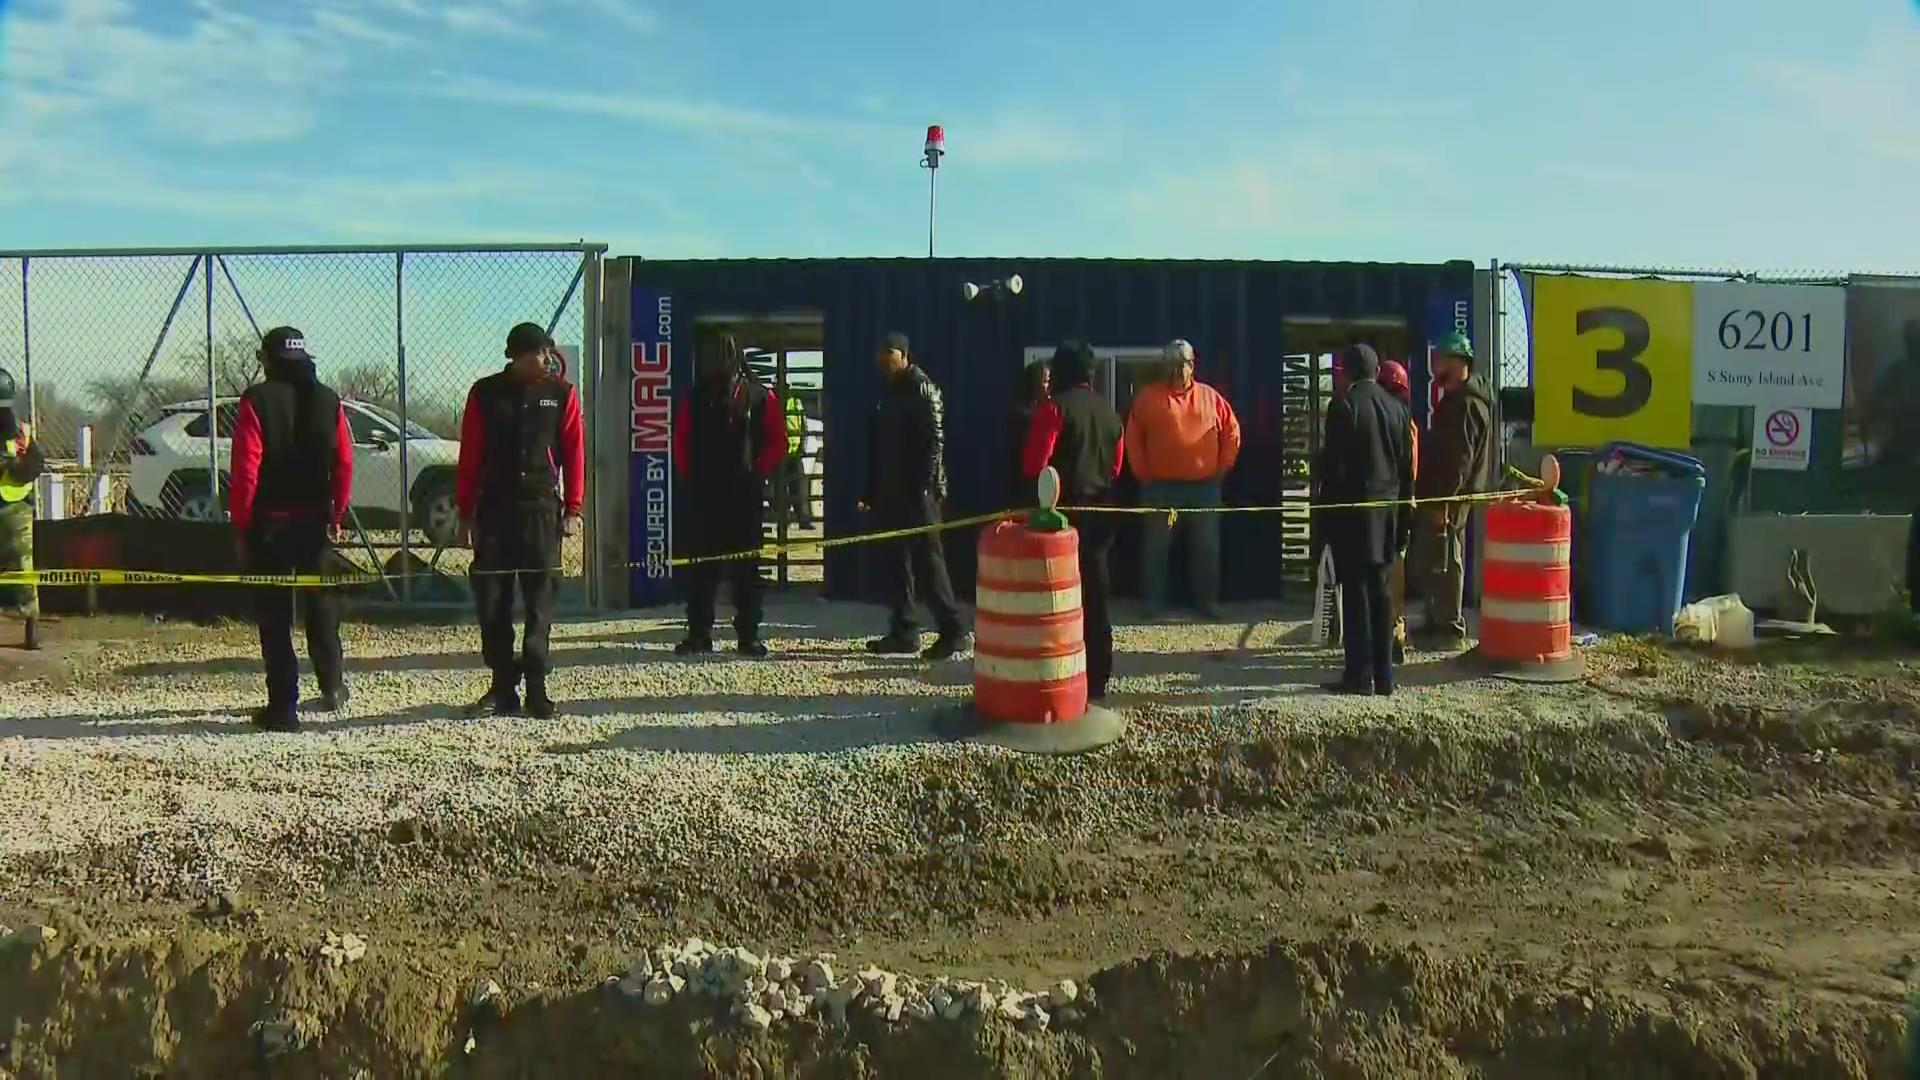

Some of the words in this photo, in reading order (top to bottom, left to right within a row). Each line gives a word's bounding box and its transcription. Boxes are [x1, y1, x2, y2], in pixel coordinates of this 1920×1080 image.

[1718, 309, 1811, 352] 6201
[1572, 306, 1652, 418] 3
[1707, 370, 1717, 383] S
[1720, 370, 1753, 387] Stony
[1759, 371, 1795, 386] Island
[1799, 373, 1824, 387] Ave
[646, 454, 665, 482] BY
[647, 487, 665, 579] SECURED
[39, 571, 101, 583] CAUTION
